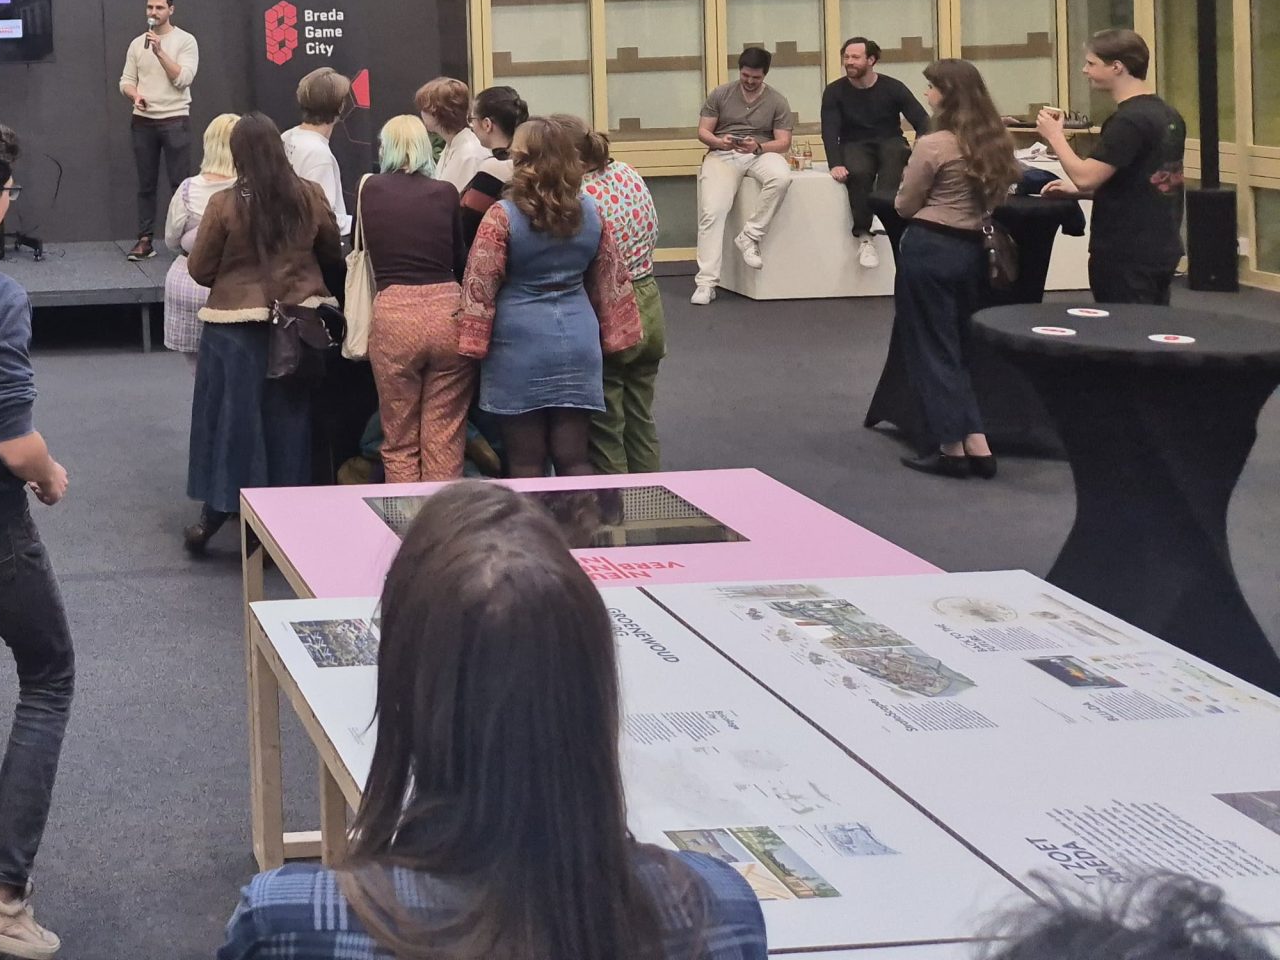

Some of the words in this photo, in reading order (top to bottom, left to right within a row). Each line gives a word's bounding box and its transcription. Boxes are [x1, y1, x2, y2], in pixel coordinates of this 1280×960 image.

[304, 8, 344, 22] Breda
[305, 26, 342, 38] Game
[305, 42, 334, 57] City
[607, 607, 680, 663] GROENEWOUD
[1024, 836, 1087, 871] ZOET
